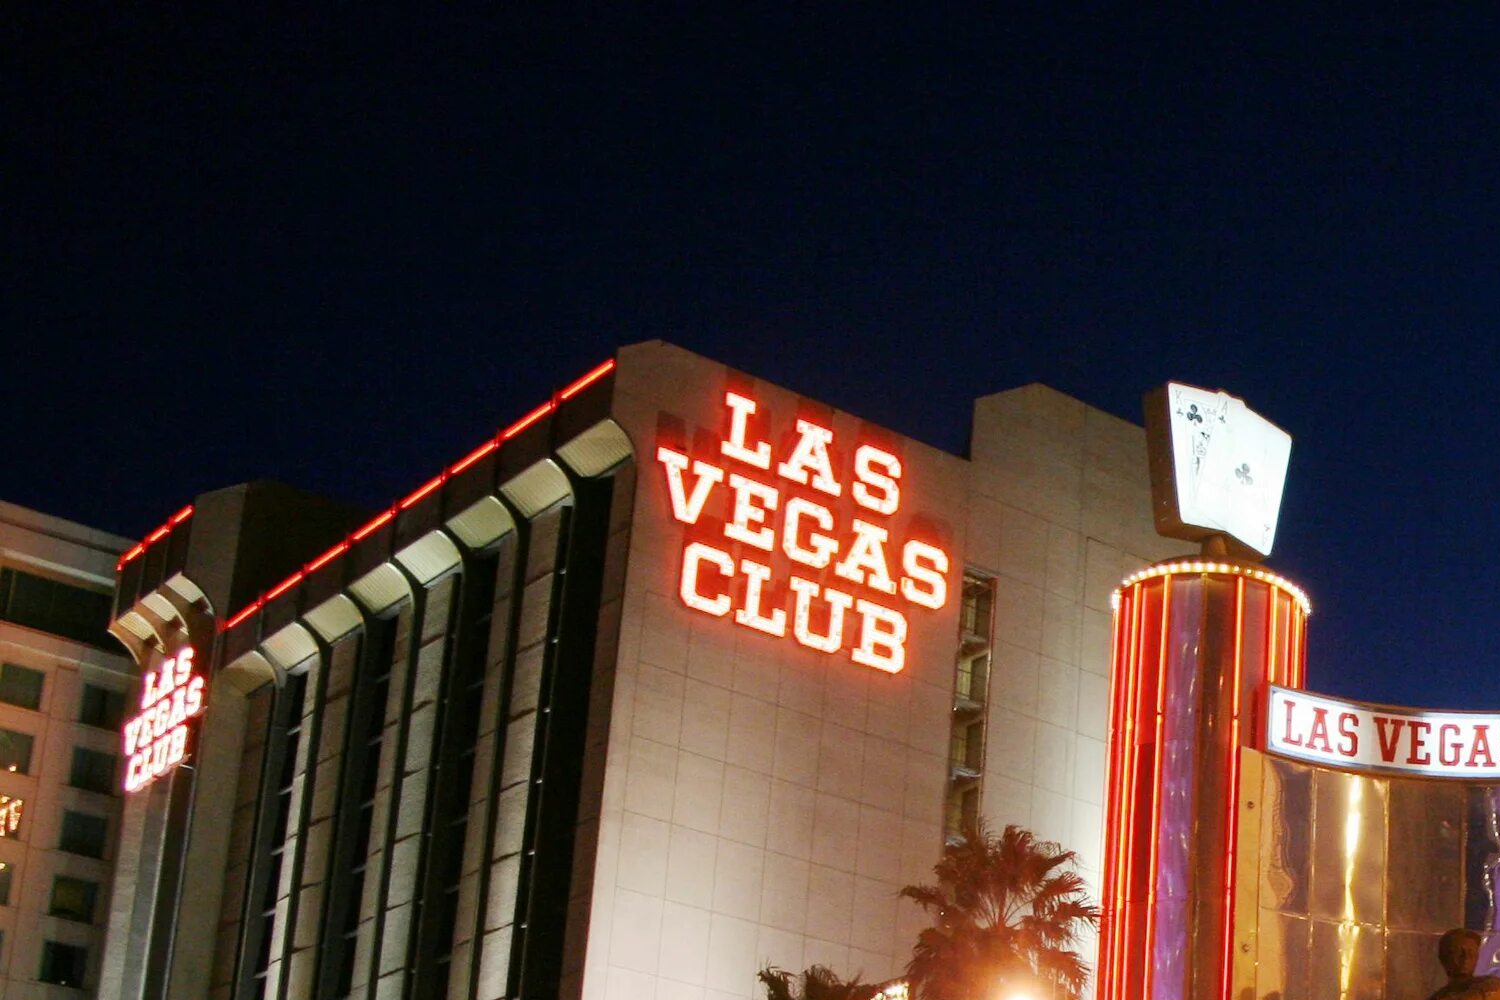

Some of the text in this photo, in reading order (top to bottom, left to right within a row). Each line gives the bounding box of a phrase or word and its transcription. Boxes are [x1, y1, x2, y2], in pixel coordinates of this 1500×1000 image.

[721, 392, 901, 515] LAS
[657, 446, 948, 610] VEGAS
[680, 542, 907, 673] CLUB
[124, 675, 204, 756] VEGAS
[141, 646, 194, 709] LAS
[124, 724, 188, 791] CLUB
[1282, 699, 1359, 757] LAS
